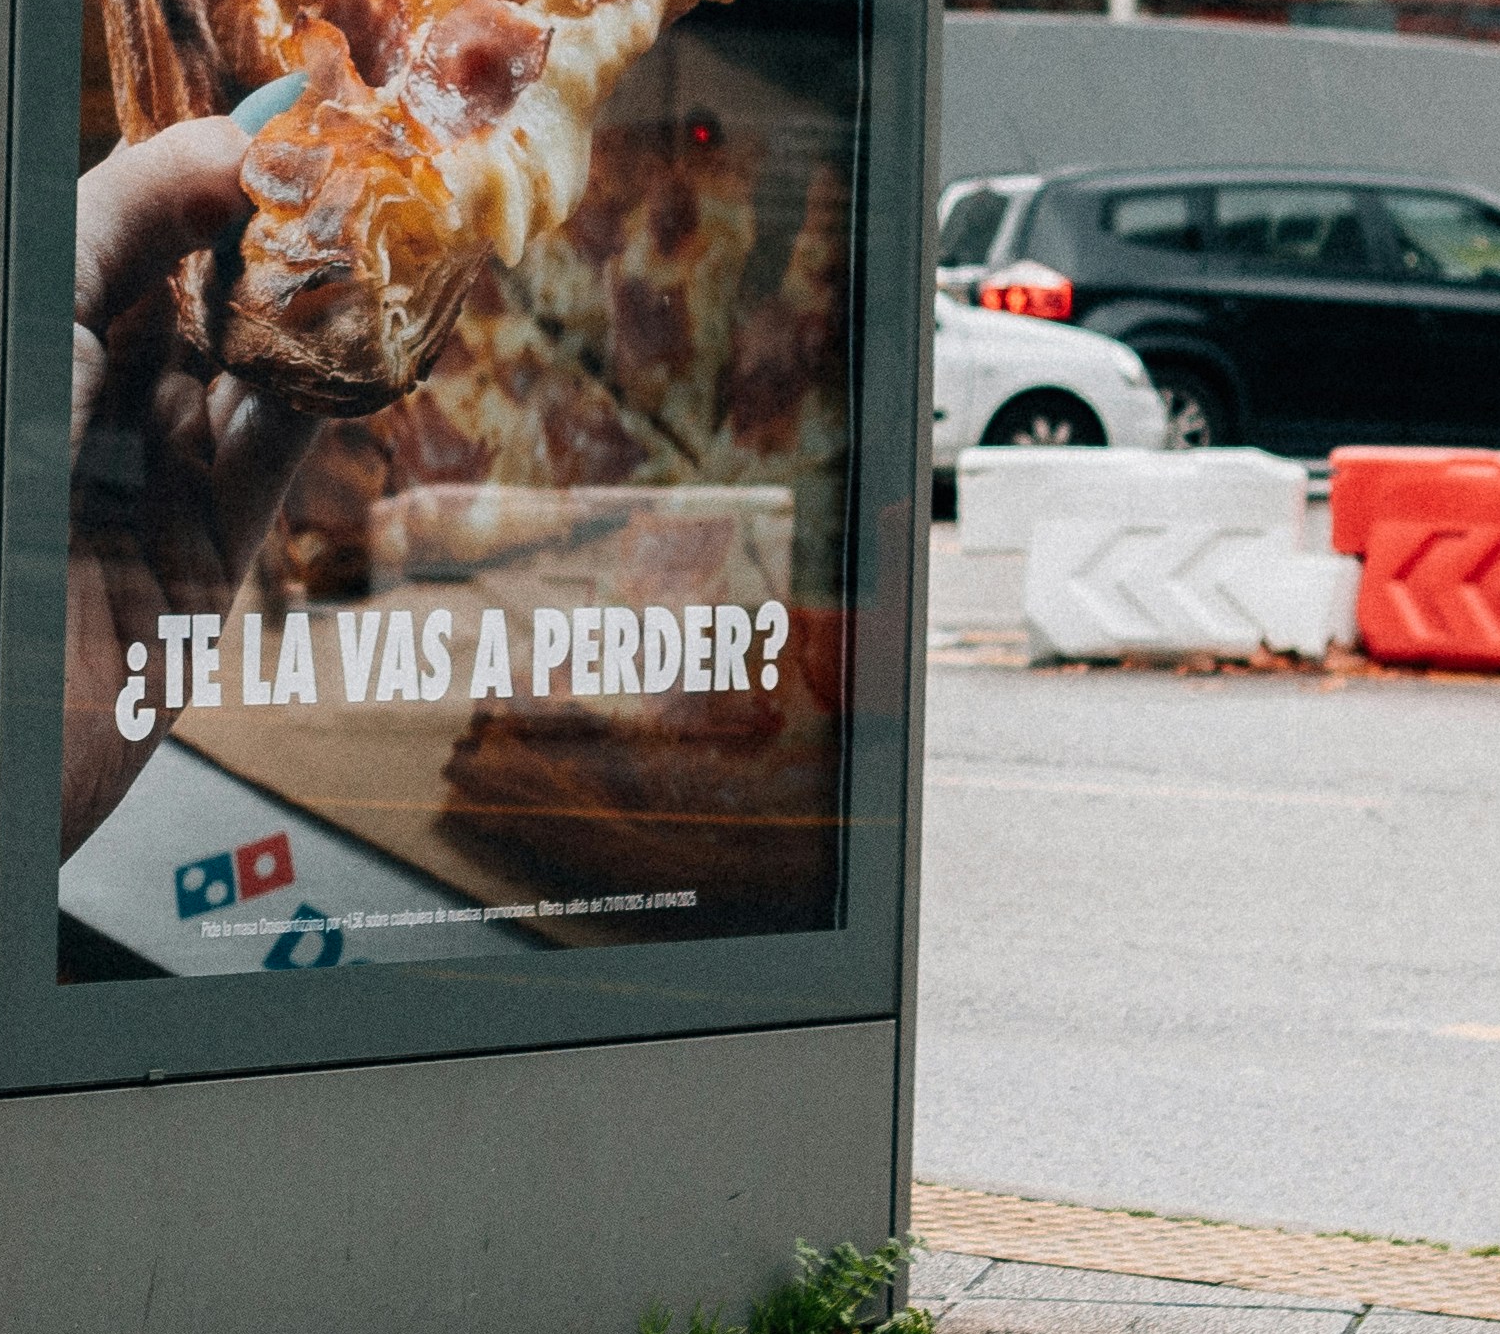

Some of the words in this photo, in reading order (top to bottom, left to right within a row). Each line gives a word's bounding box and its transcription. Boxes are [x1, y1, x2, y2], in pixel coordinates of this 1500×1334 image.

[115, 612, 222, 742] ¿TE
[242, 612, 318, 706] LA
[336, 608, 454, 704] VAS
[468, 608, 513, 699] A
[532, 600, 788, 698] PERDER?
[326, 916, 343, 934] por
[365, 911, 390, 928] sobre
[434, 907, 447, 923] de
[538, 899, 564, 917] Oferta
[590, 896, 604, 913] del
